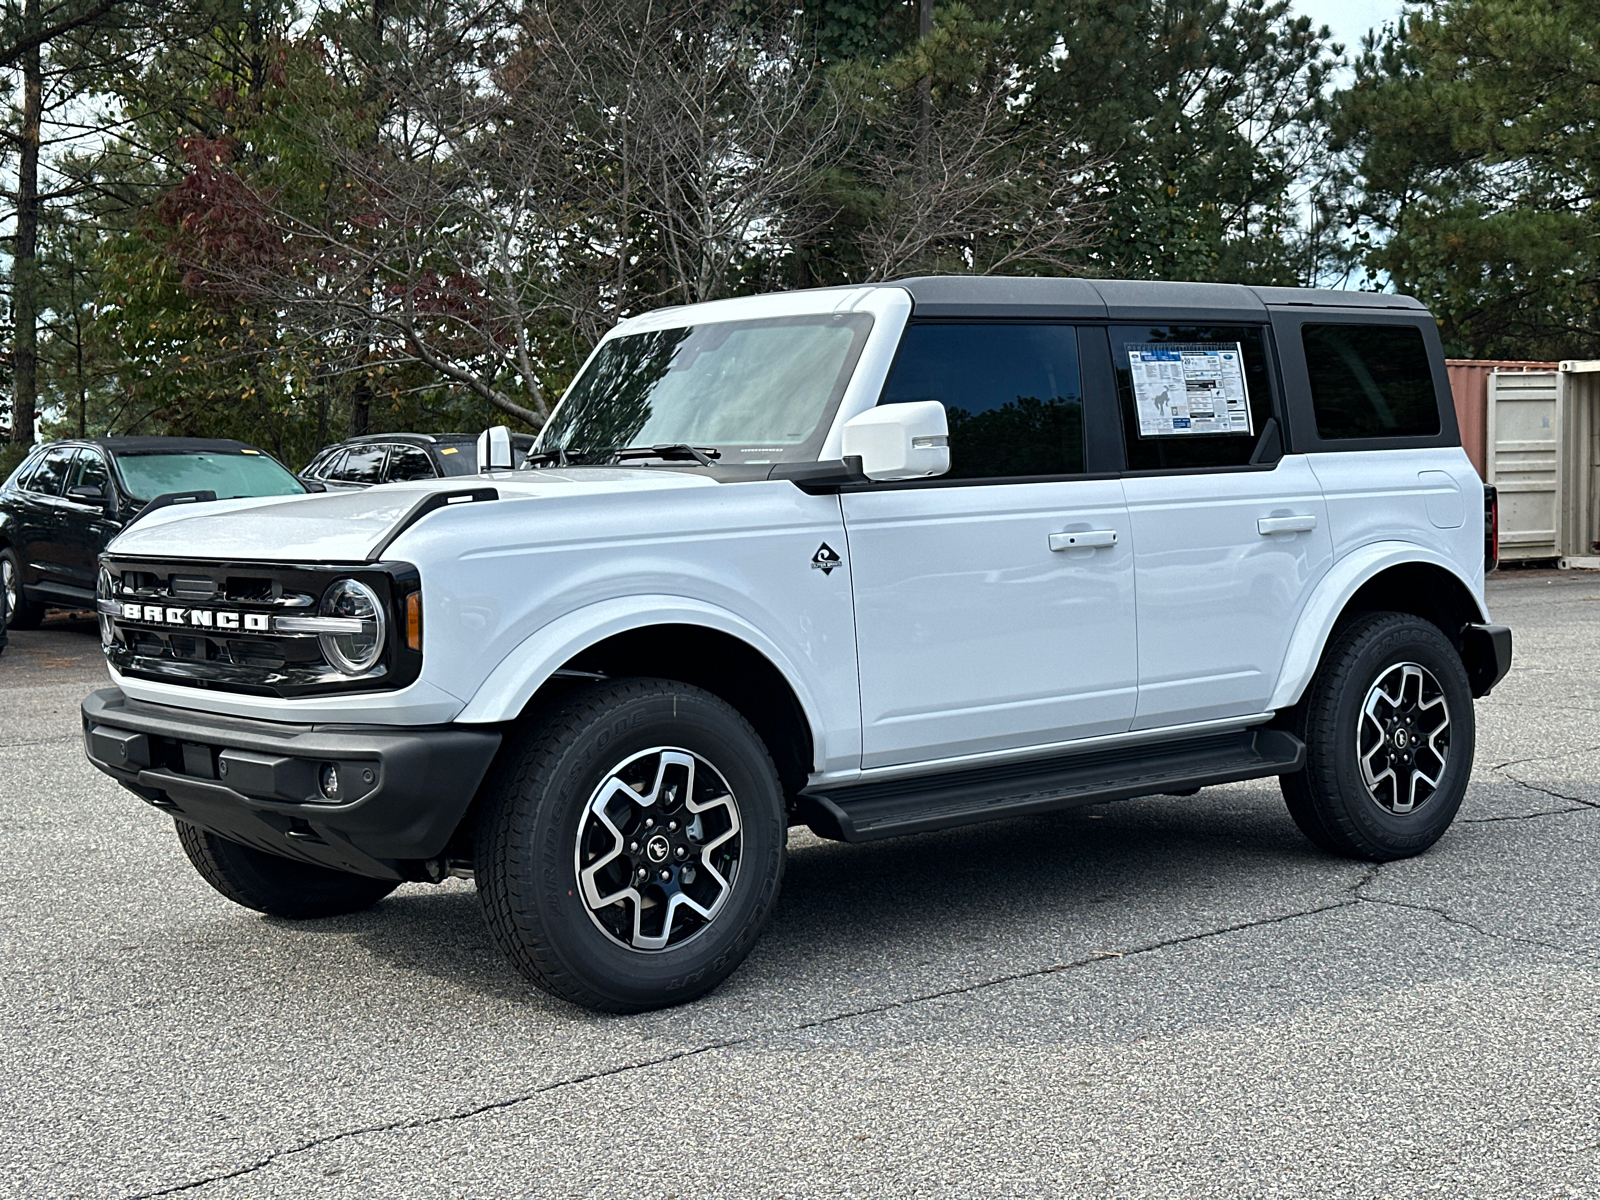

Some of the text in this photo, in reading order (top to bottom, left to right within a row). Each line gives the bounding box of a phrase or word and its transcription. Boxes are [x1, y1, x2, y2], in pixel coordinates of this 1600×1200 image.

[124, 603, 269, 631] BRONCO
[544, 707, 646, 917] BRIDGESTONE
[713, 816, 780, 974] DUELER
